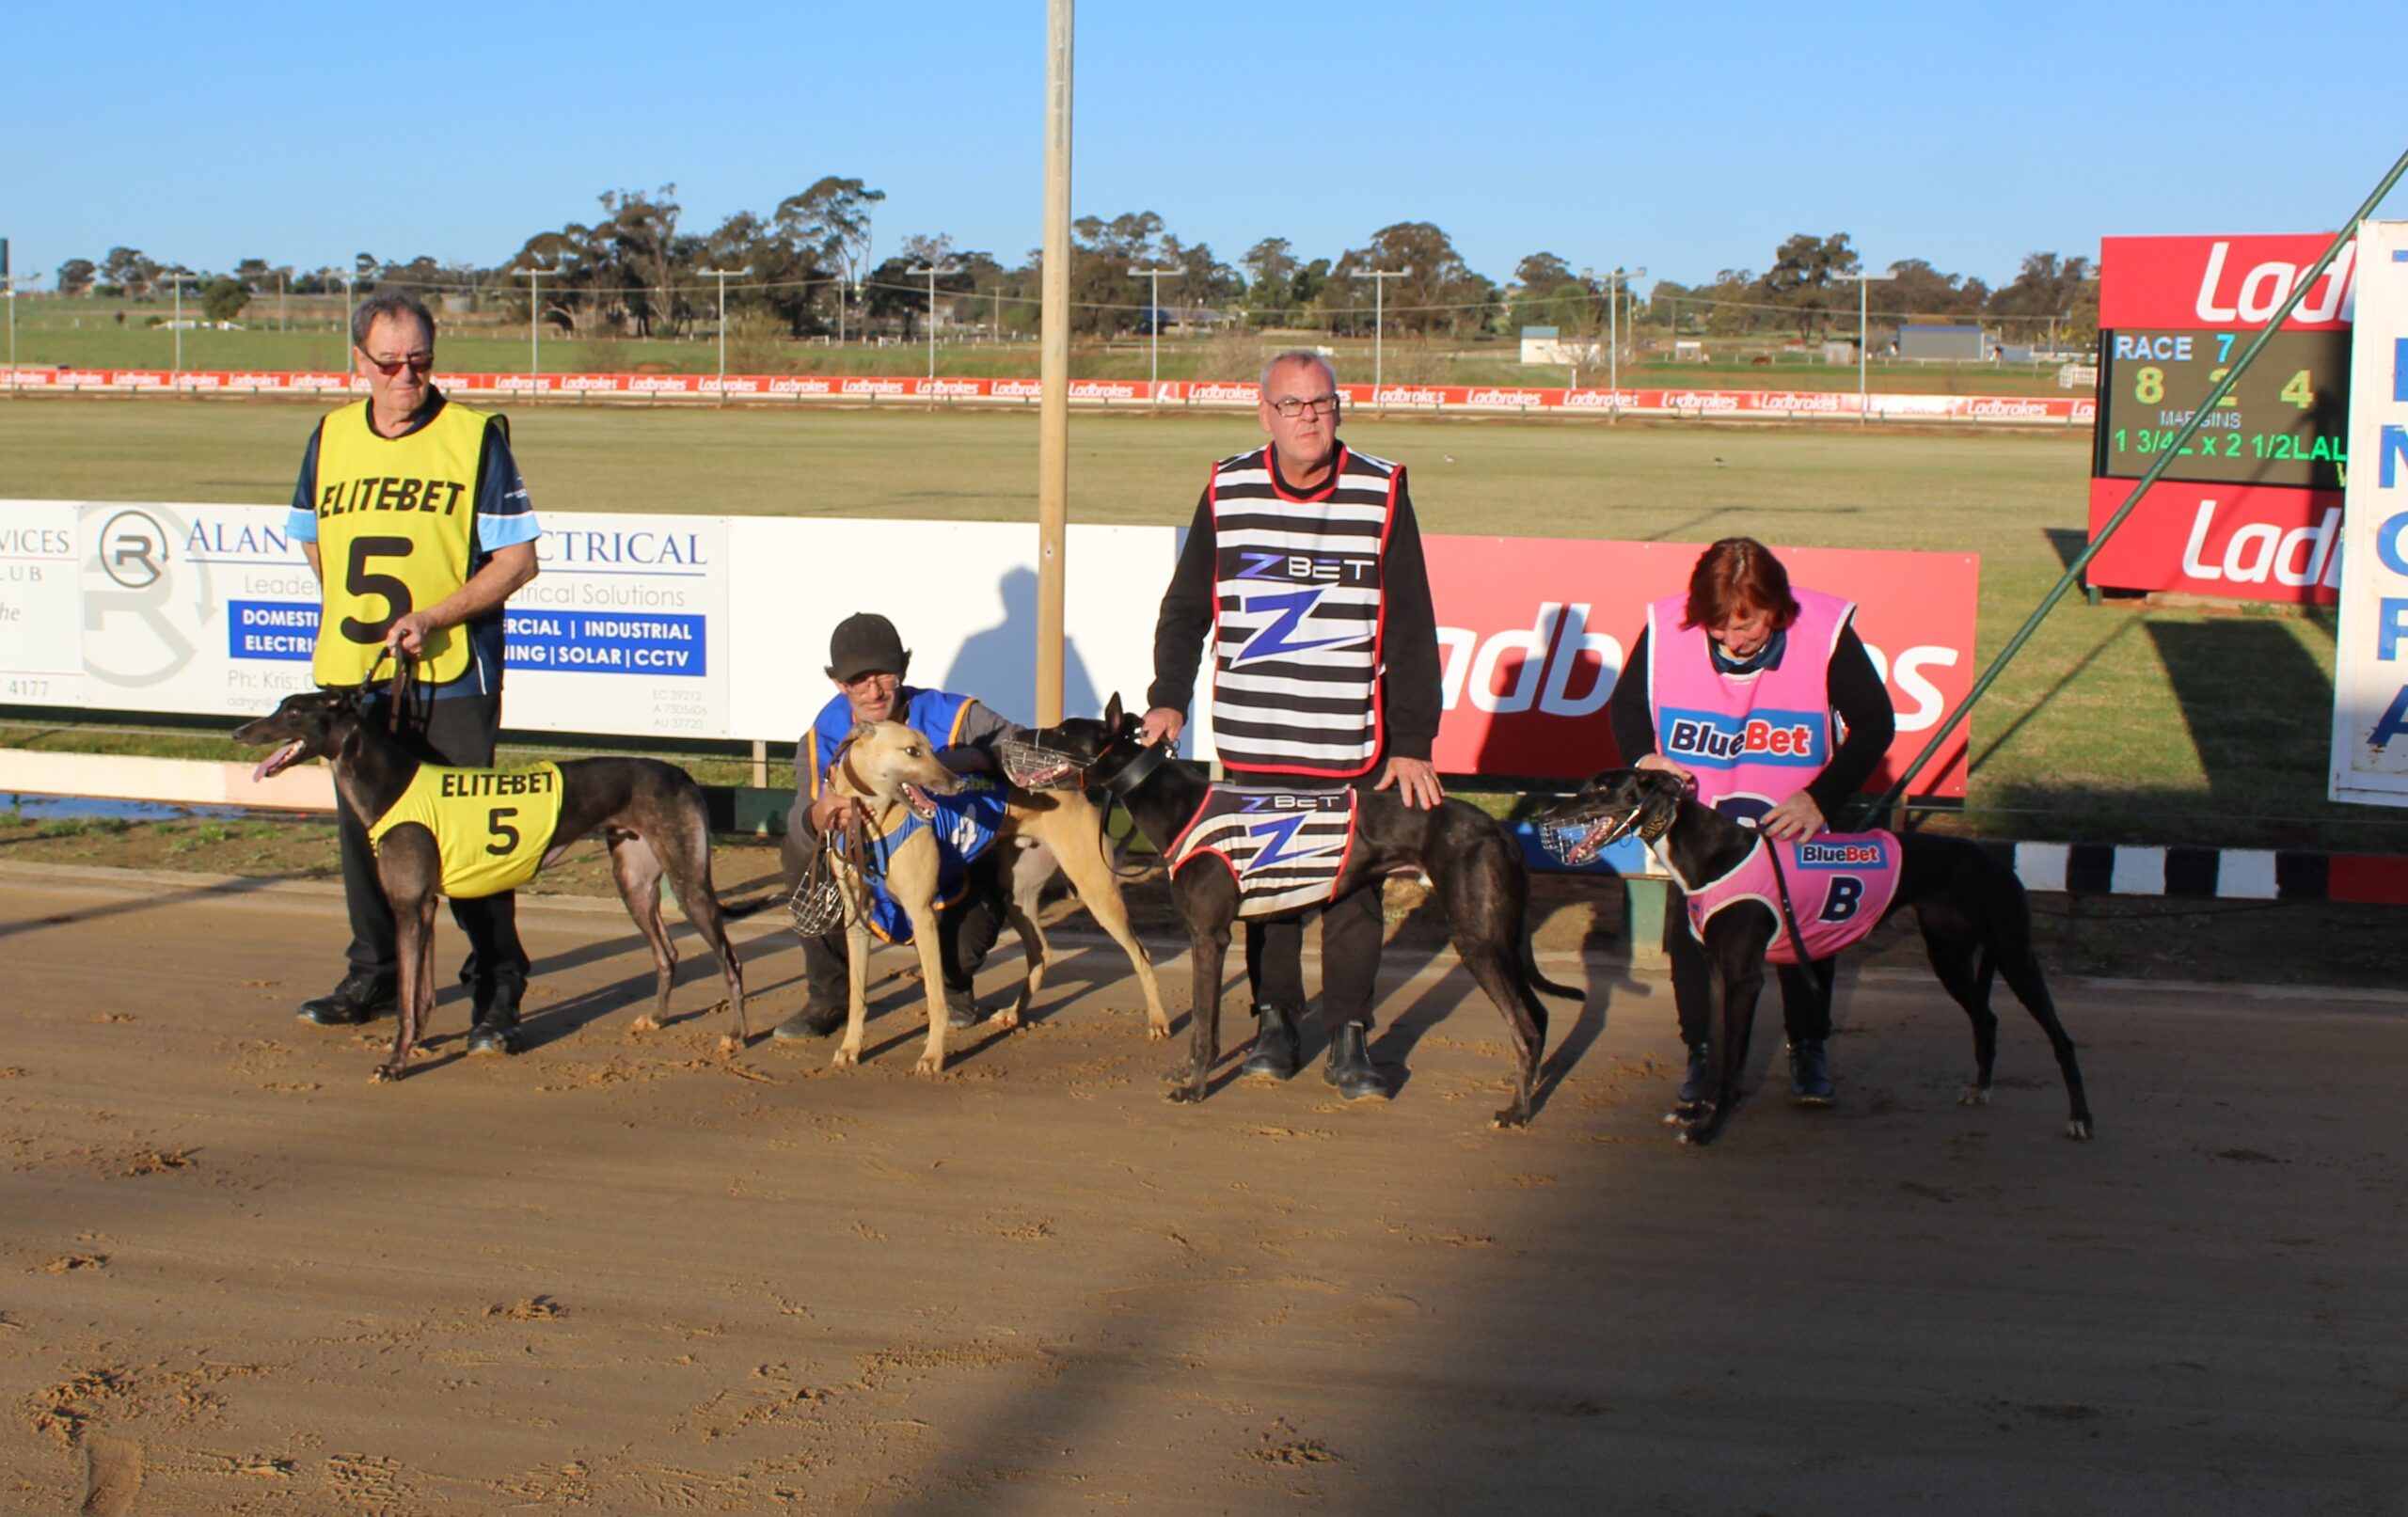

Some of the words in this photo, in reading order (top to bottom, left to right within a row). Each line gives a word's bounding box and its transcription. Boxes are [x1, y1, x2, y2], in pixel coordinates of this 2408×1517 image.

[2195, 240, 2356, 324] Lad
[2115, 336, 2193, 360] RACE
[2216, 334, 2235, 363] 7
[562, 376, 617, 389] Ladbrokes
[628, 377, 687, 391] Ladbrokes
[769, 378, 830, 392] Ladbrokes
[841, 379, 903, 393] Ladbrokes
[990, 380, 1041, 395] Ladbrok
[1068, 382, 1133, 398] Ladbrokes
[1188, 384, 1259, 399] Ladbrokes
[1466, 387, 1541, 405] Ladbrokes
[2134, 367, 2164, 404] 8
[2210, 368, 2238, 406] 2
[2280, 370, 2314, 409] 4
[1761, 393, 1839, 411] Ladbrokes
[1967, 399, 2048, 416] Ladbrokes
[2115, 428, 2127, 452] 1
[2201, 435, 2218, 456] x
[2226, 433, 2242, 457] 2
[320, 477, 466, 518] ELITEBET
[185, 518, 289, 554] ALAN
[2182, 499, 2341, 589] Lad
[0, 564, 42, 582] UB
[340, 536, 414, 645] 5
[509, 582, 576, 604] trical
[582, 583, 685, 607] Solutions
[243, 608, 320, 627] DOMESTI
[584, 621, 692, 640] INDUSTRIAL
[245, 634, 316, 654] ELECTRI
[558, 646, 622, 664] SOLAR
[633, 649, 689, 667] CCTV
[1668, 719, 1813, 760] BlueBet
[441, 771, 553, 798] ELITEBET
[485, 807, 519, 855] 5
[1801, 845, 1880, 864] BlueBet
[1817, 874, 1865, 924] B
